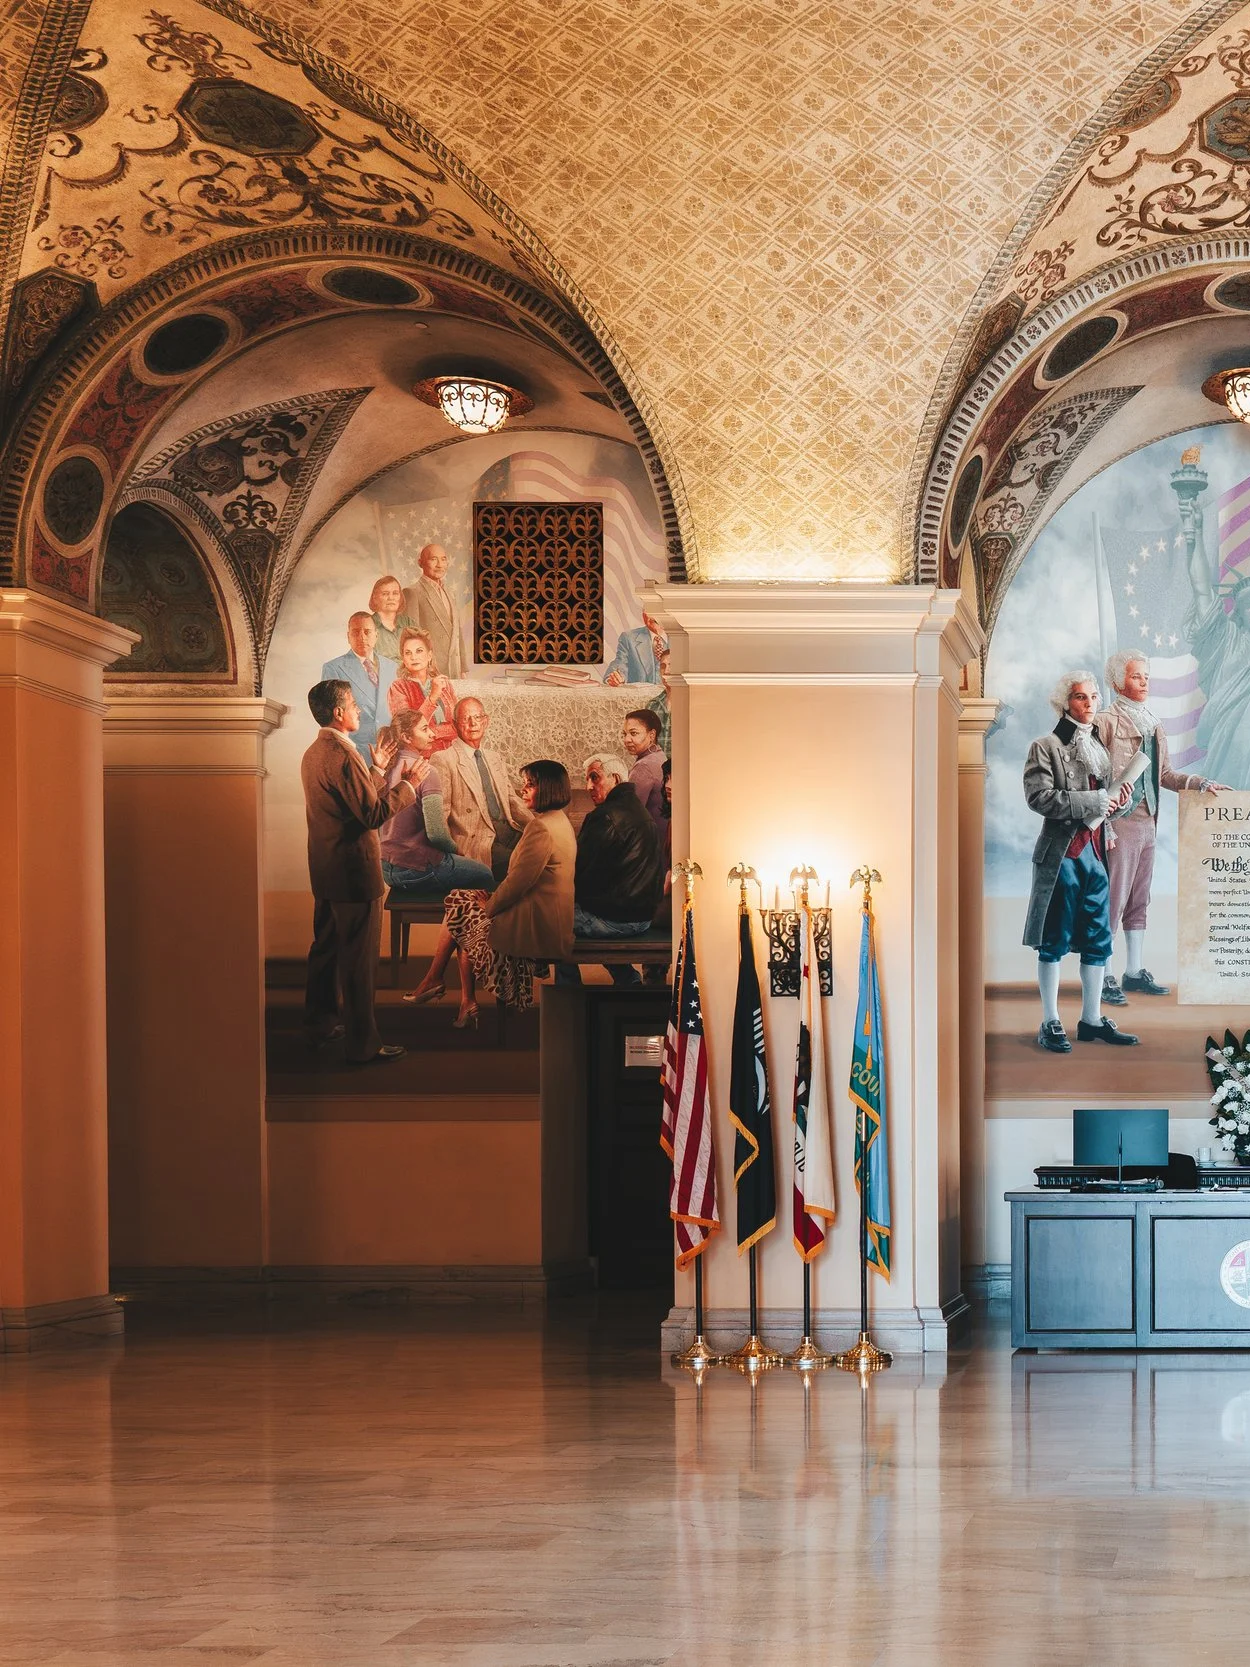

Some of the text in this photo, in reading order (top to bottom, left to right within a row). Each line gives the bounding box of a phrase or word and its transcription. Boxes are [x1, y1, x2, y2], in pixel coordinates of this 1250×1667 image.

[1202, 857, 1230, 872] We
[1229, 856, 1248, 873] the
[1209, 924, 1230, 932] general
